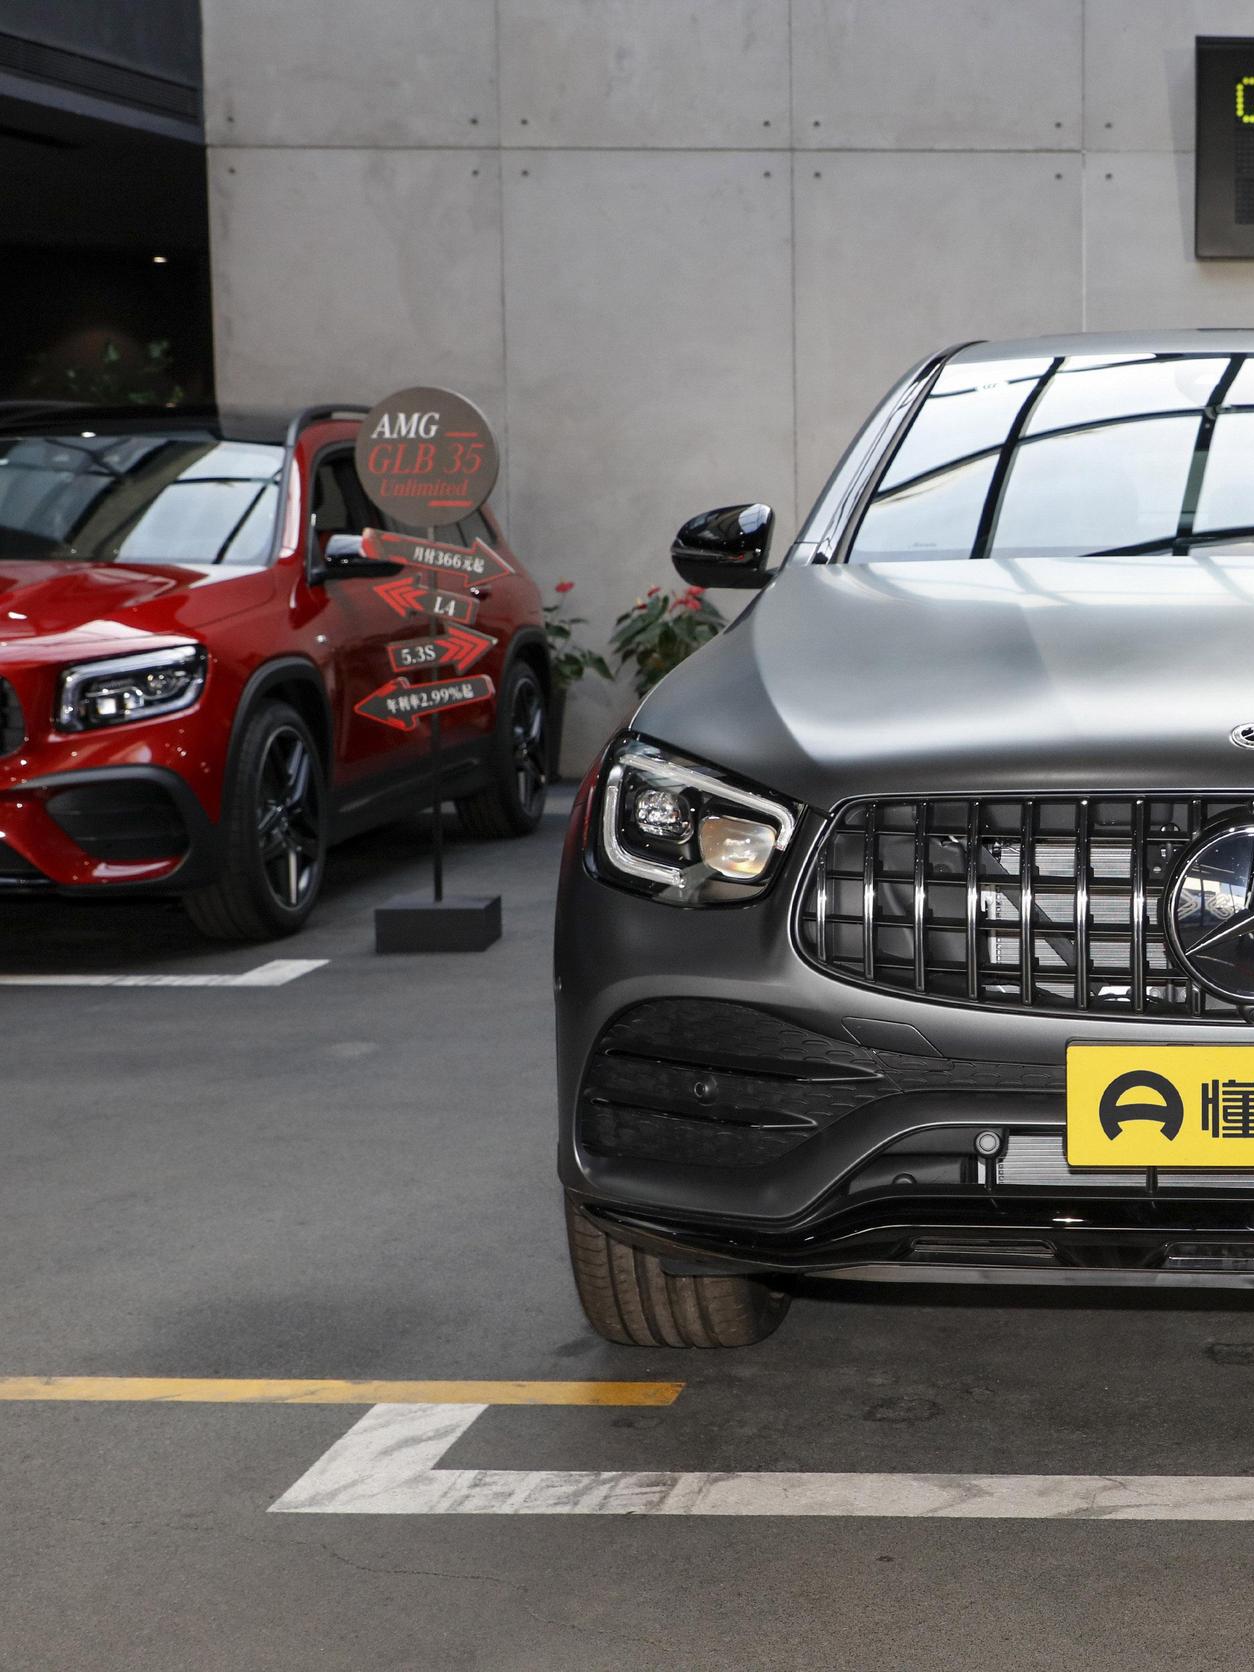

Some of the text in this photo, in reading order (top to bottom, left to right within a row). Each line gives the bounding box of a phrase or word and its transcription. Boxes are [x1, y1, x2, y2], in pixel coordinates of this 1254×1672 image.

[370, 412, 440, 439] AMG
[368, 442, 486, 474] GLB 35
[380, 478, 469, 497] Unlimited
[433, 596, 456, 616] L4
[401, 644, 436, 665] 5.3S
